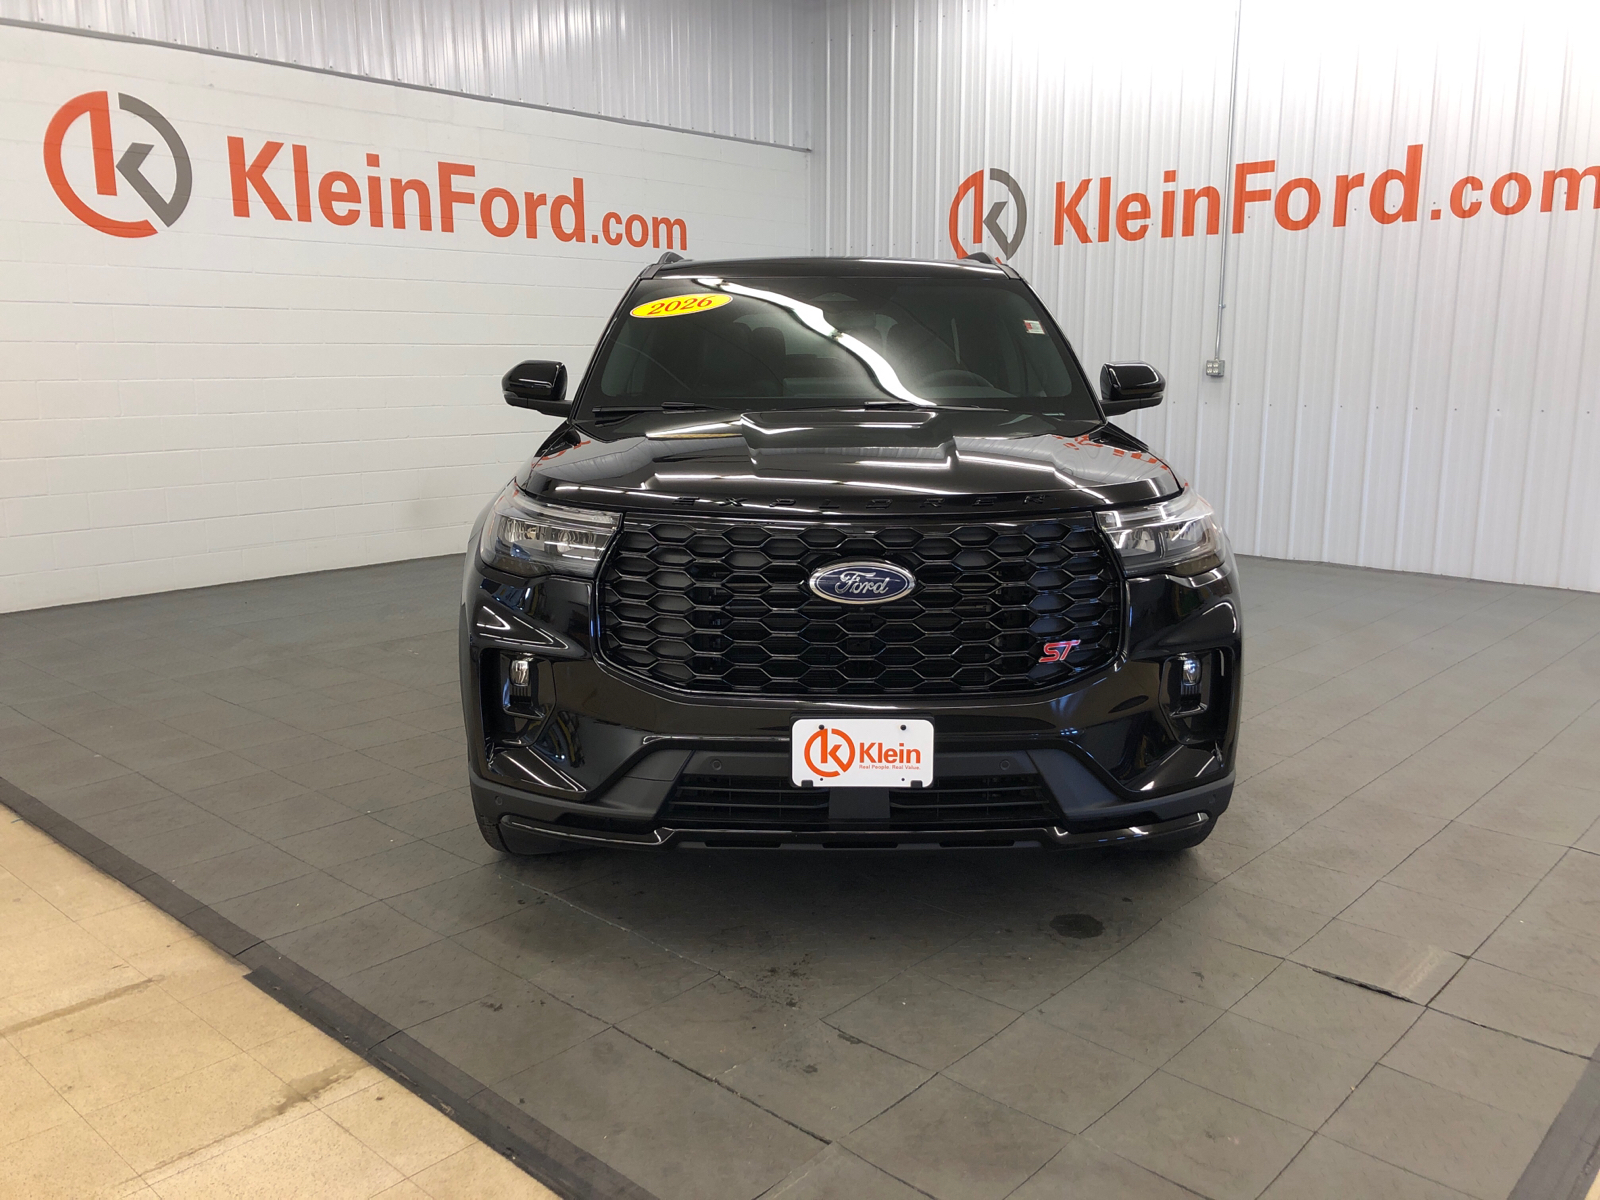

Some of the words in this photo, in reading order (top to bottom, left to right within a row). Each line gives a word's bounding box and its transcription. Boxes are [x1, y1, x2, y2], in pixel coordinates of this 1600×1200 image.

[227, 135, 689, 251] KleinFord.com
[1053, 143, 1600, 246] KleinFord.com
[647, 296, 716, 315] 2026
[671, 493, 1047, 510] EXPLORER
[835, 571, 890, 594] Ford
[1039, 640, 1081, 662] ST
[859, 742, 921, 764] Klein
